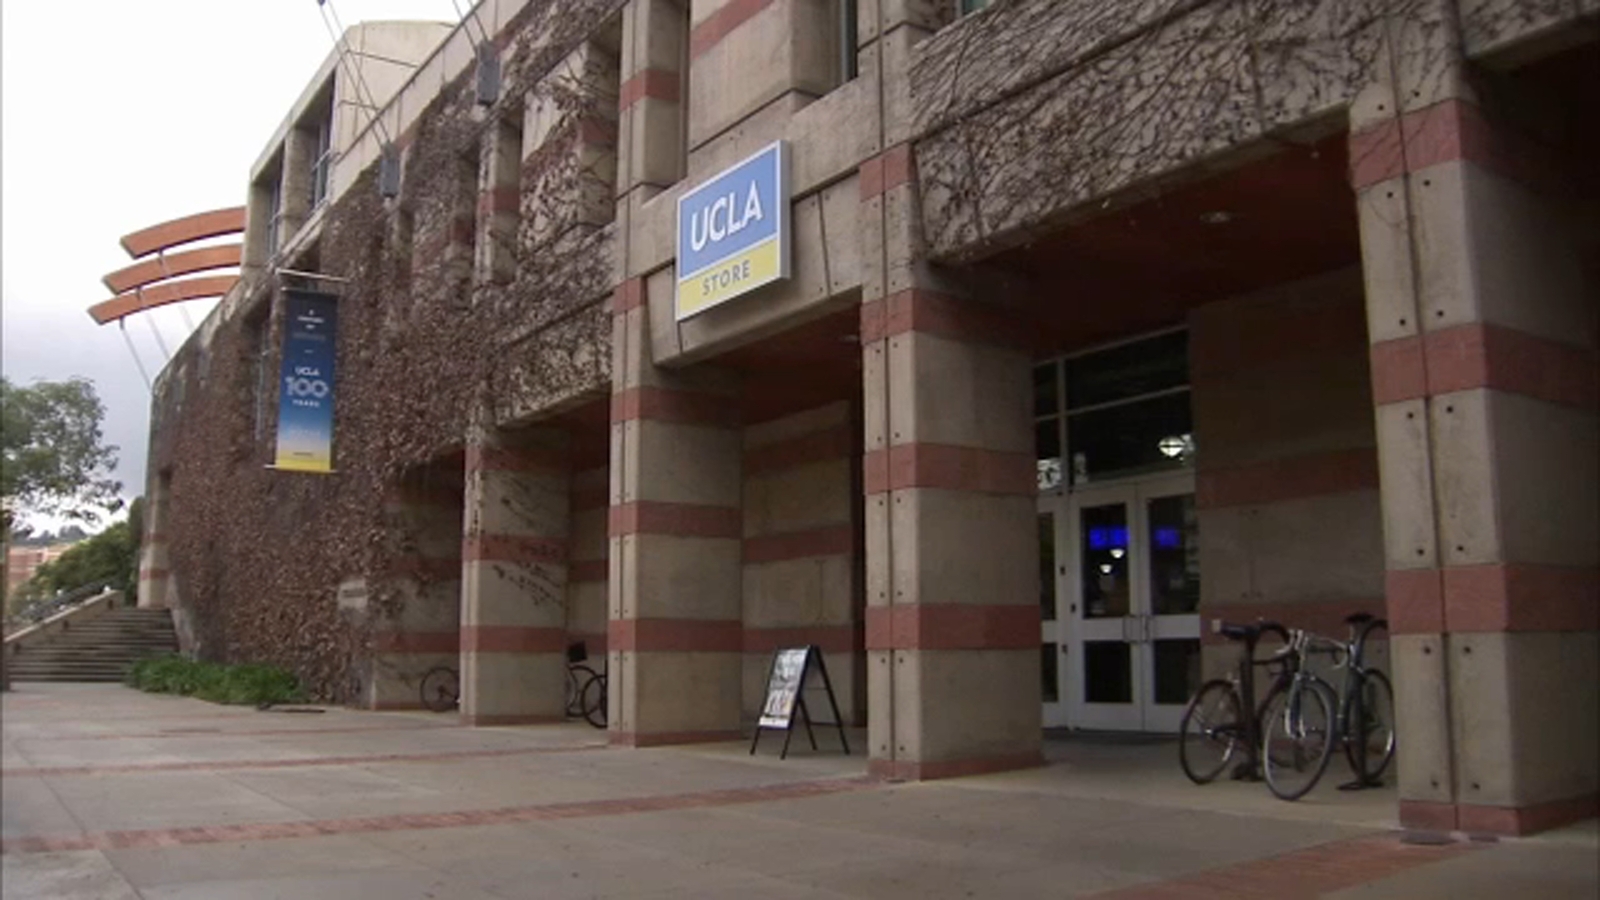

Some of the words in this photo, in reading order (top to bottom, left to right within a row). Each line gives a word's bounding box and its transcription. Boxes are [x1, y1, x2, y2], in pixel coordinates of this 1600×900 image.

[691, 180, 763, 252] UCLA
[702, 259, 751, 296] STORE
[294, 366, 321, 377] UCLA
[284, 377, 330, 399] 100
